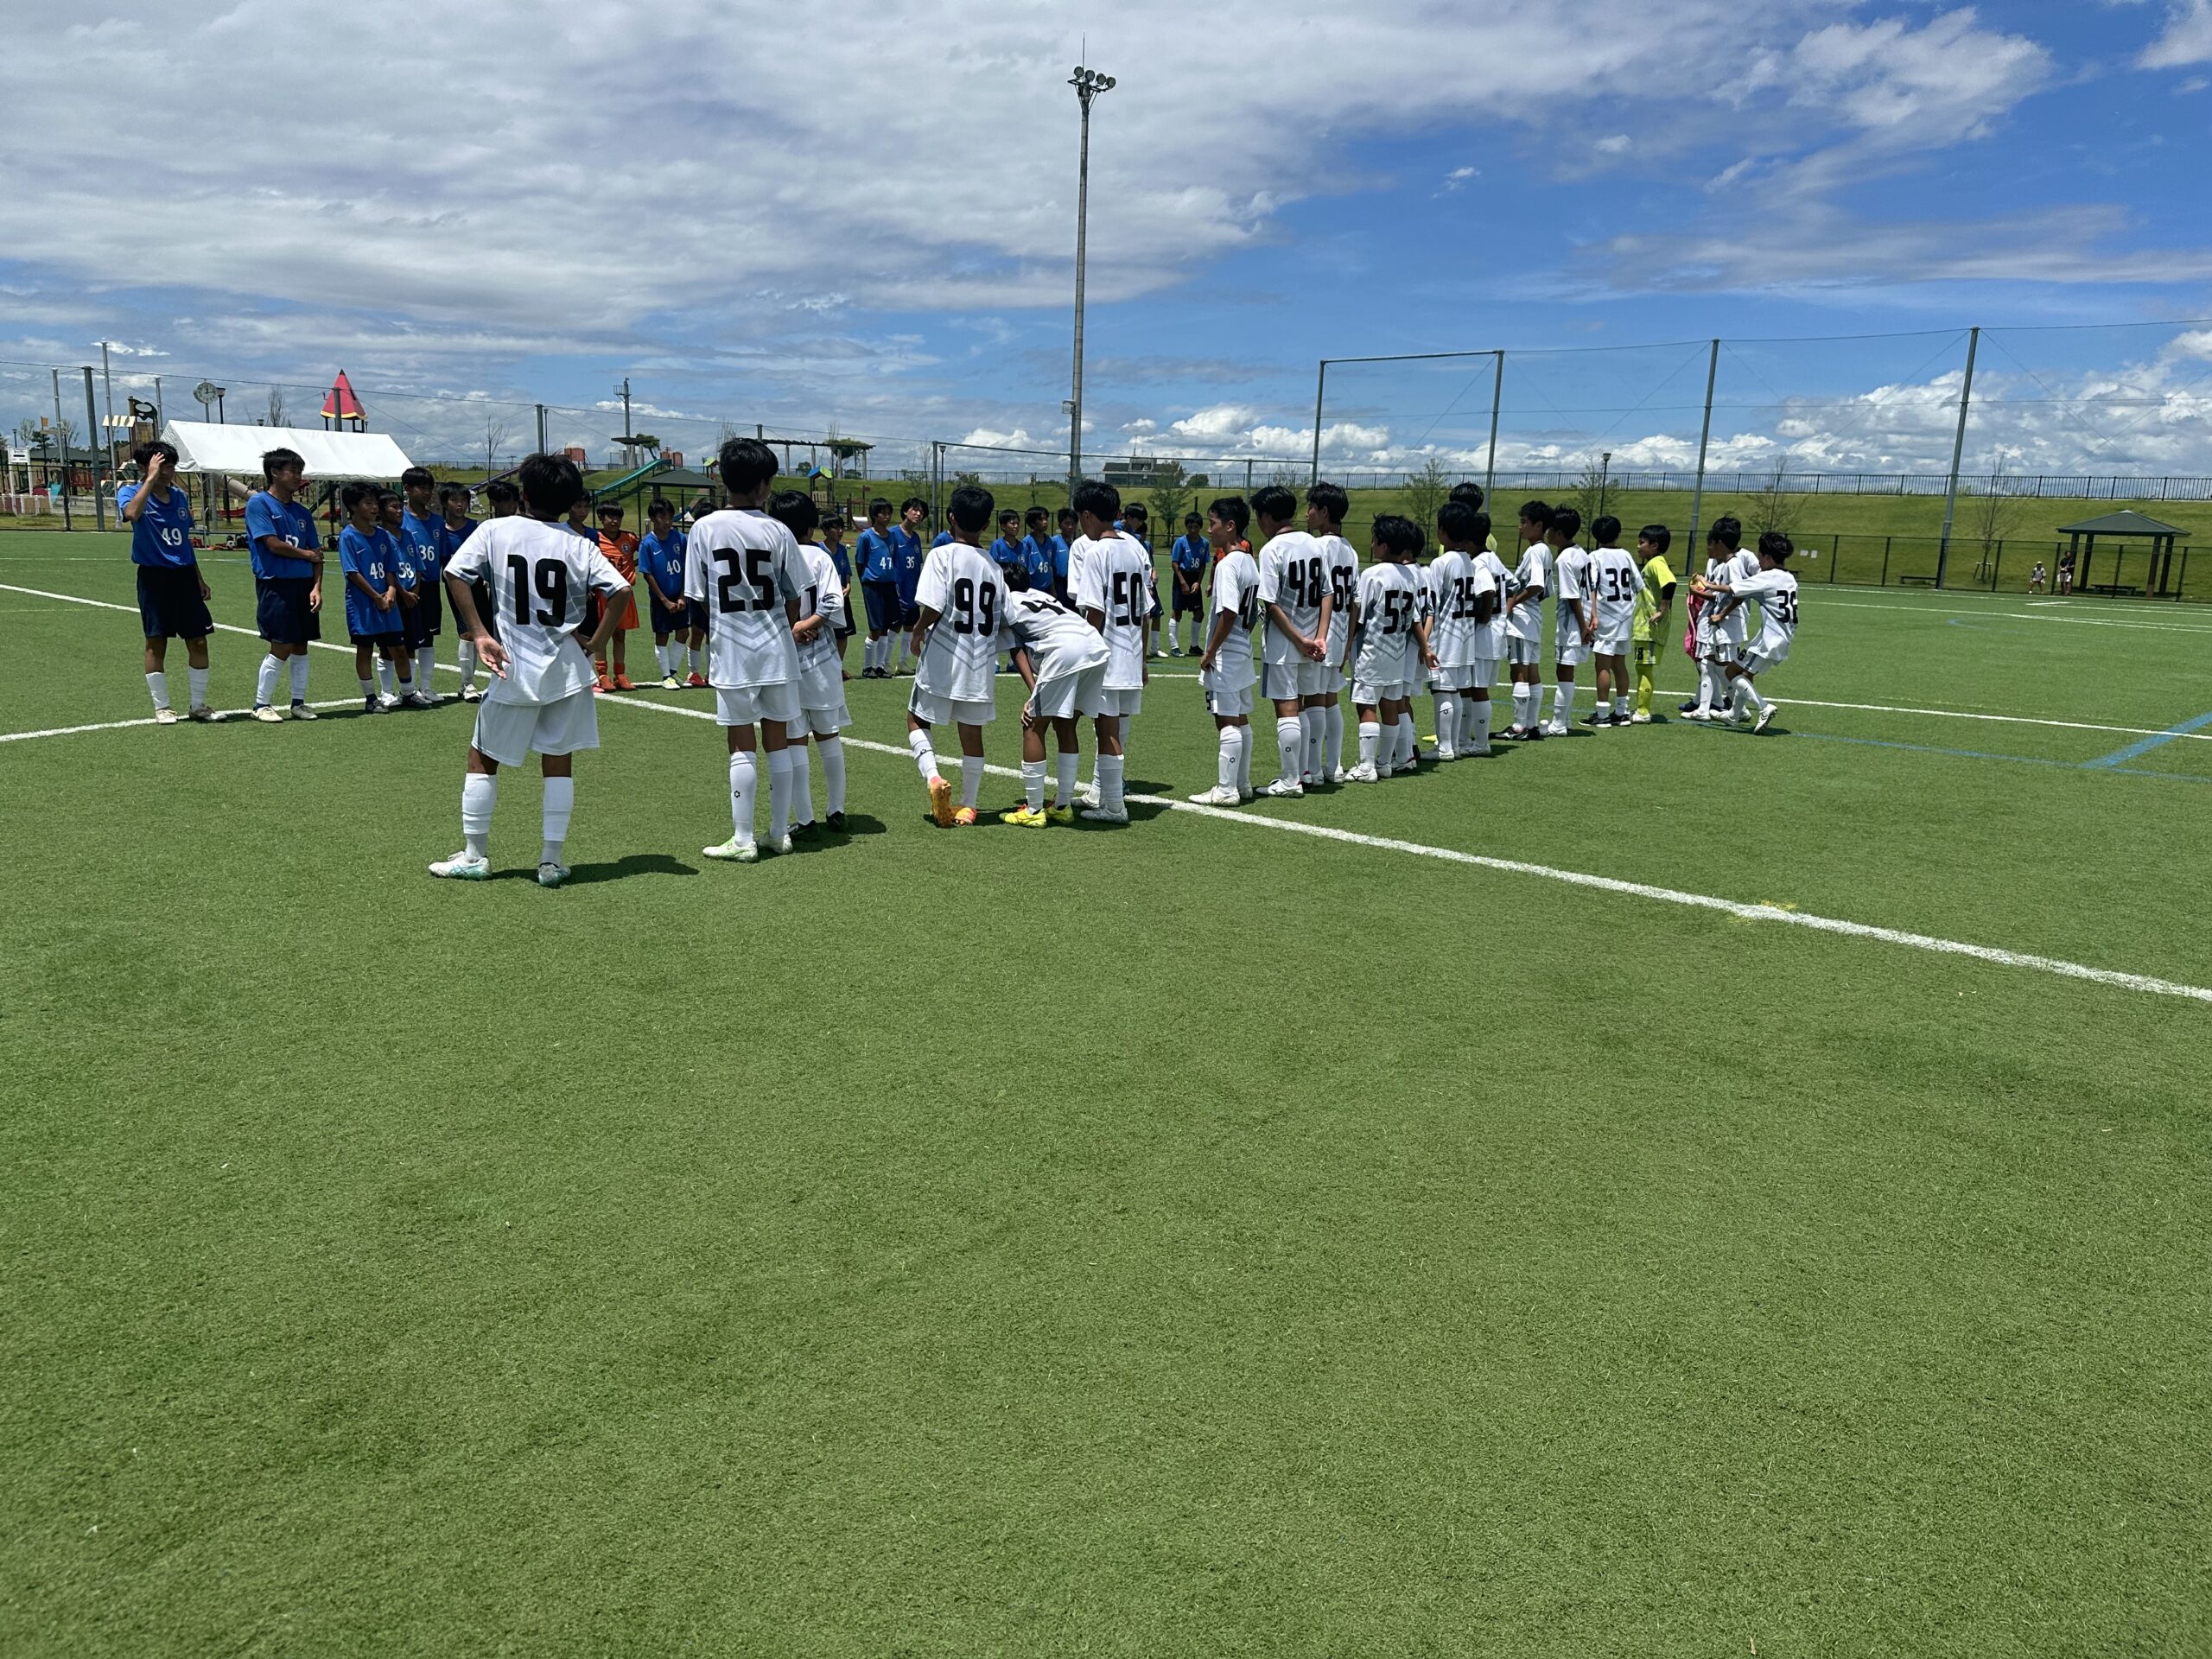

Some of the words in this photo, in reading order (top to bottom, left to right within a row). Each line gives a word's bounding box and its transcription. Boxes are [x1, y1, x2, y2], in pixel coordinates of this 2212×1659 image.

[162, 527, 182, 546] 49
[418, 544, 435, 561] 36
[370, 563, 385, 579] 48
[398, 563, 415, 579] 58
[666, 559, 681, 575] 40
[906, 556, 915, 569] 35
[1038, 562, 1048, 573] 46
[1191, 557, 1200, 569] 38
[712, 548, 775, 613] 25
[1289, 557, 1321, 607] 48
[1605, 568, 1632, 601] 39
[507, 554, 568, 627] 19
[1113, 572, 1142, 626] 50
[955, 578, 996, 637] 99
